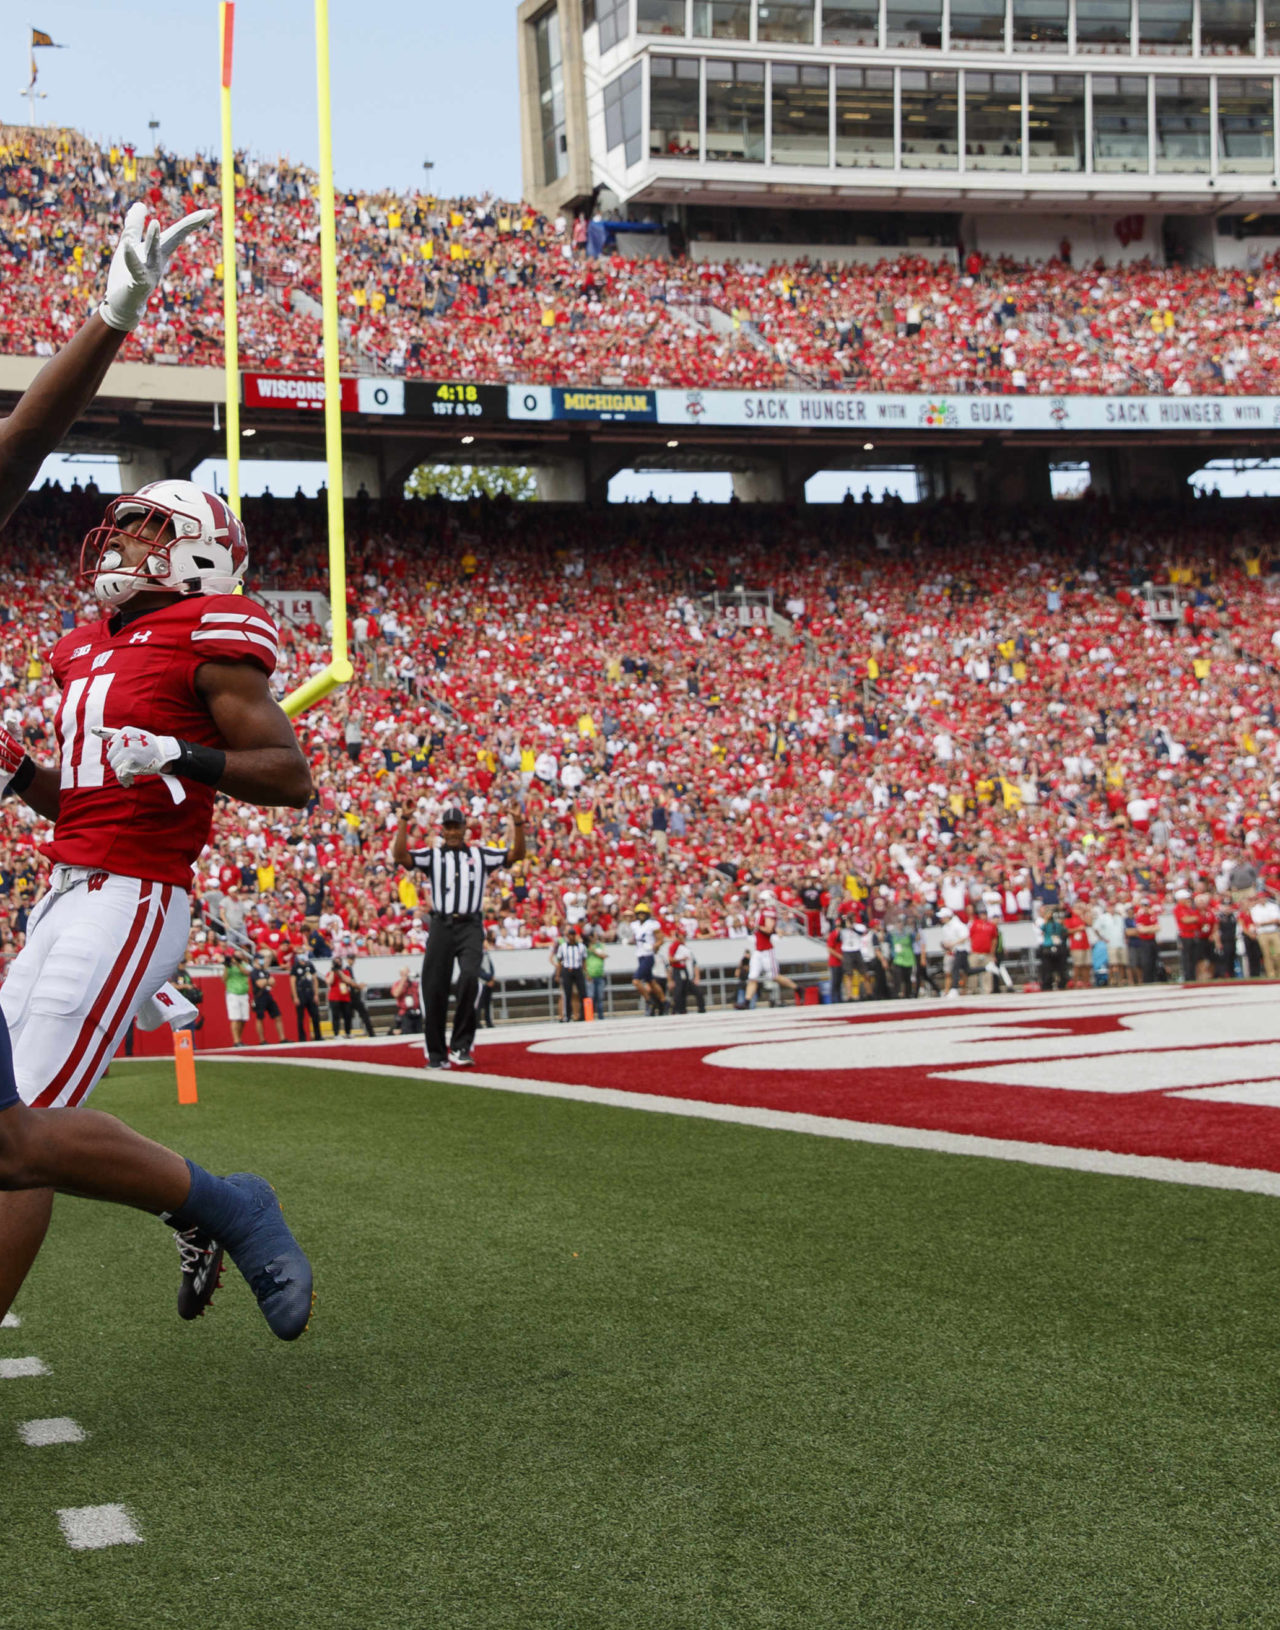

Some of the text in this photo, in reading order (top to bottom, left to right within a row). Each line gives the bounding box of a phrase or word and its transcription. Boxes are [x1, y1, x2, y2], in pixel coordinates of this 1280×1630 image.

[256, 378, 389, 406] WISCONS 0
[436, 384, 478, 401] 4:18
[432, 402, 454, 415] 1ST
[466, 403, 483, 416] 10
[523, 393, 648, 412] 0 MICHIGAN
[745, 400, 789, 420] SACK
[800, 400, 867, 421] HUNGER
[970, 402, 1014, 422] GUAC
[1105, 403, 1149, 423] SACK
[1160, 403, 1222, 423] HUNGER
[60, 672, 116, 790] 11
[88, 872, 110, 893] W
